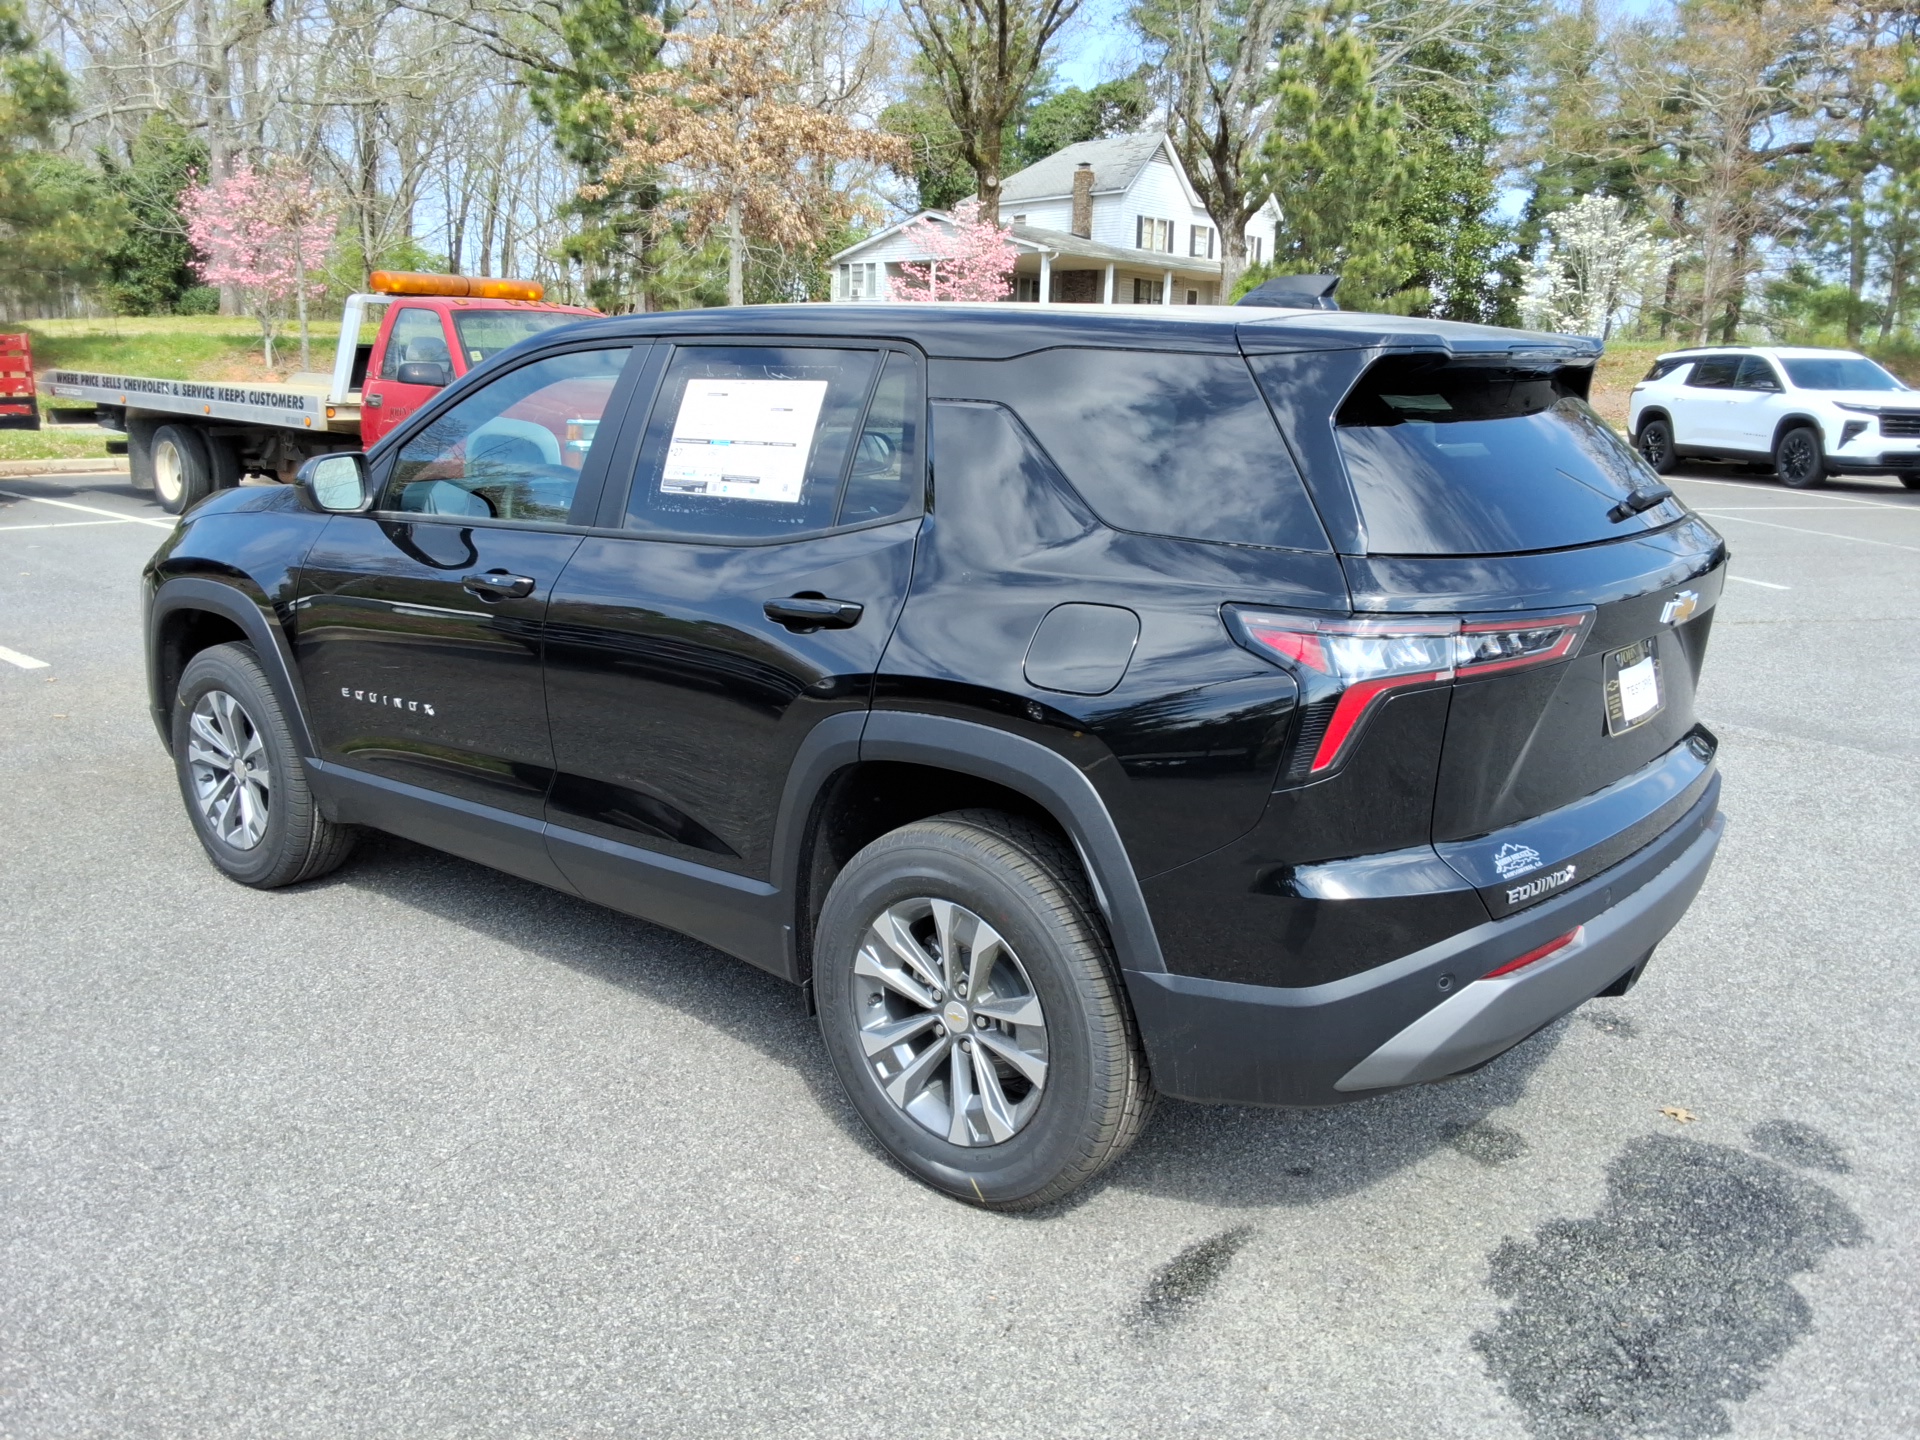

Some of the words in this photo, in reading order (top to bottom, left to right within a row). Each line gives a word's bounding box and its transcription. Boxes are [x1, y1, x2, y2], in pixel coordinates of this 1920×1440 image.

[56, 372, 79, 385] WHERE
[80, 374, 99, 387] PRICE
[102, 376, 122, 389] SELLS
[123, 378, 170, 395] CHEVROLETS
[172, 383, 179, 396] &
[182, 383, 215, 400] SERVICE
[218, 387, 246, 403] KEEPS
[249, 390, 305, 410] CUSTOMERS
[341, 687, 436, 717] EQUINOX
[1506, 864, 1577, 905] EQUINOX
